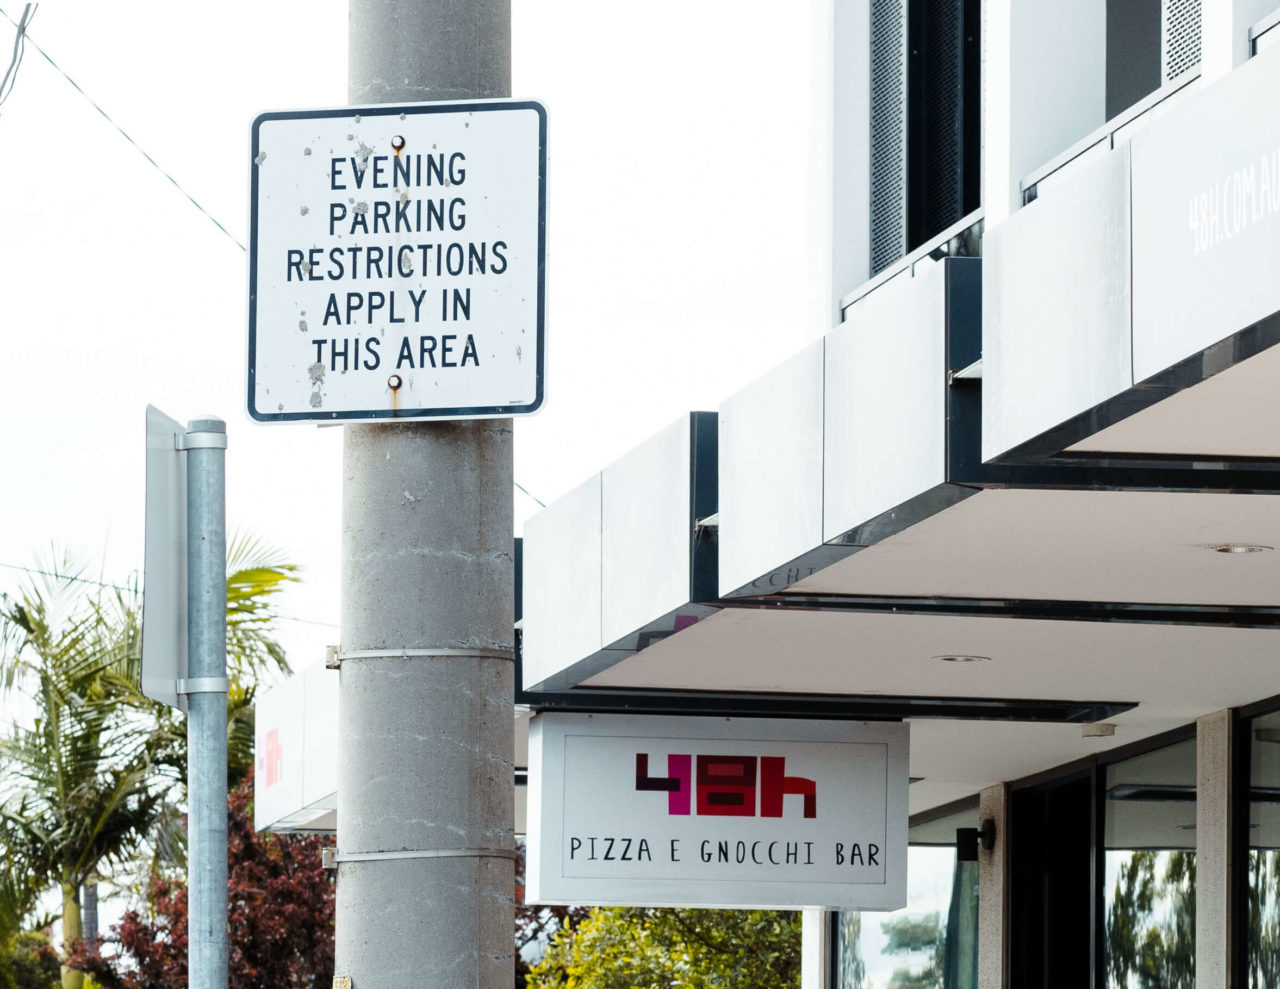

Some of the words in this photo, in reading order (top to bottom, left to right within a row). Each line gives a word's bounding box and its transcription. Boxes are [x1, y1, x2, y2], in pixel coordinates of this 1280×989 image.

[330, 152, 466, 190] EVENING
[329, 198, 466, 235] PARKING
[287, 241, 508, 281] RESTRICTIONS
[323, 290, 426, 325] APPLY
[443, 288, 471, 321] IN
[312, 338, 381, 371] THIS
[396, 334, 479, 369] AREA
[636, 753, 816, 818] 48h
[570, 837, 652, 862] PIZZA
[671, 840, 680, 862] E
[701, 840, 814, 865] GNOCCHI
[836, 842, 880, 867] BAR
